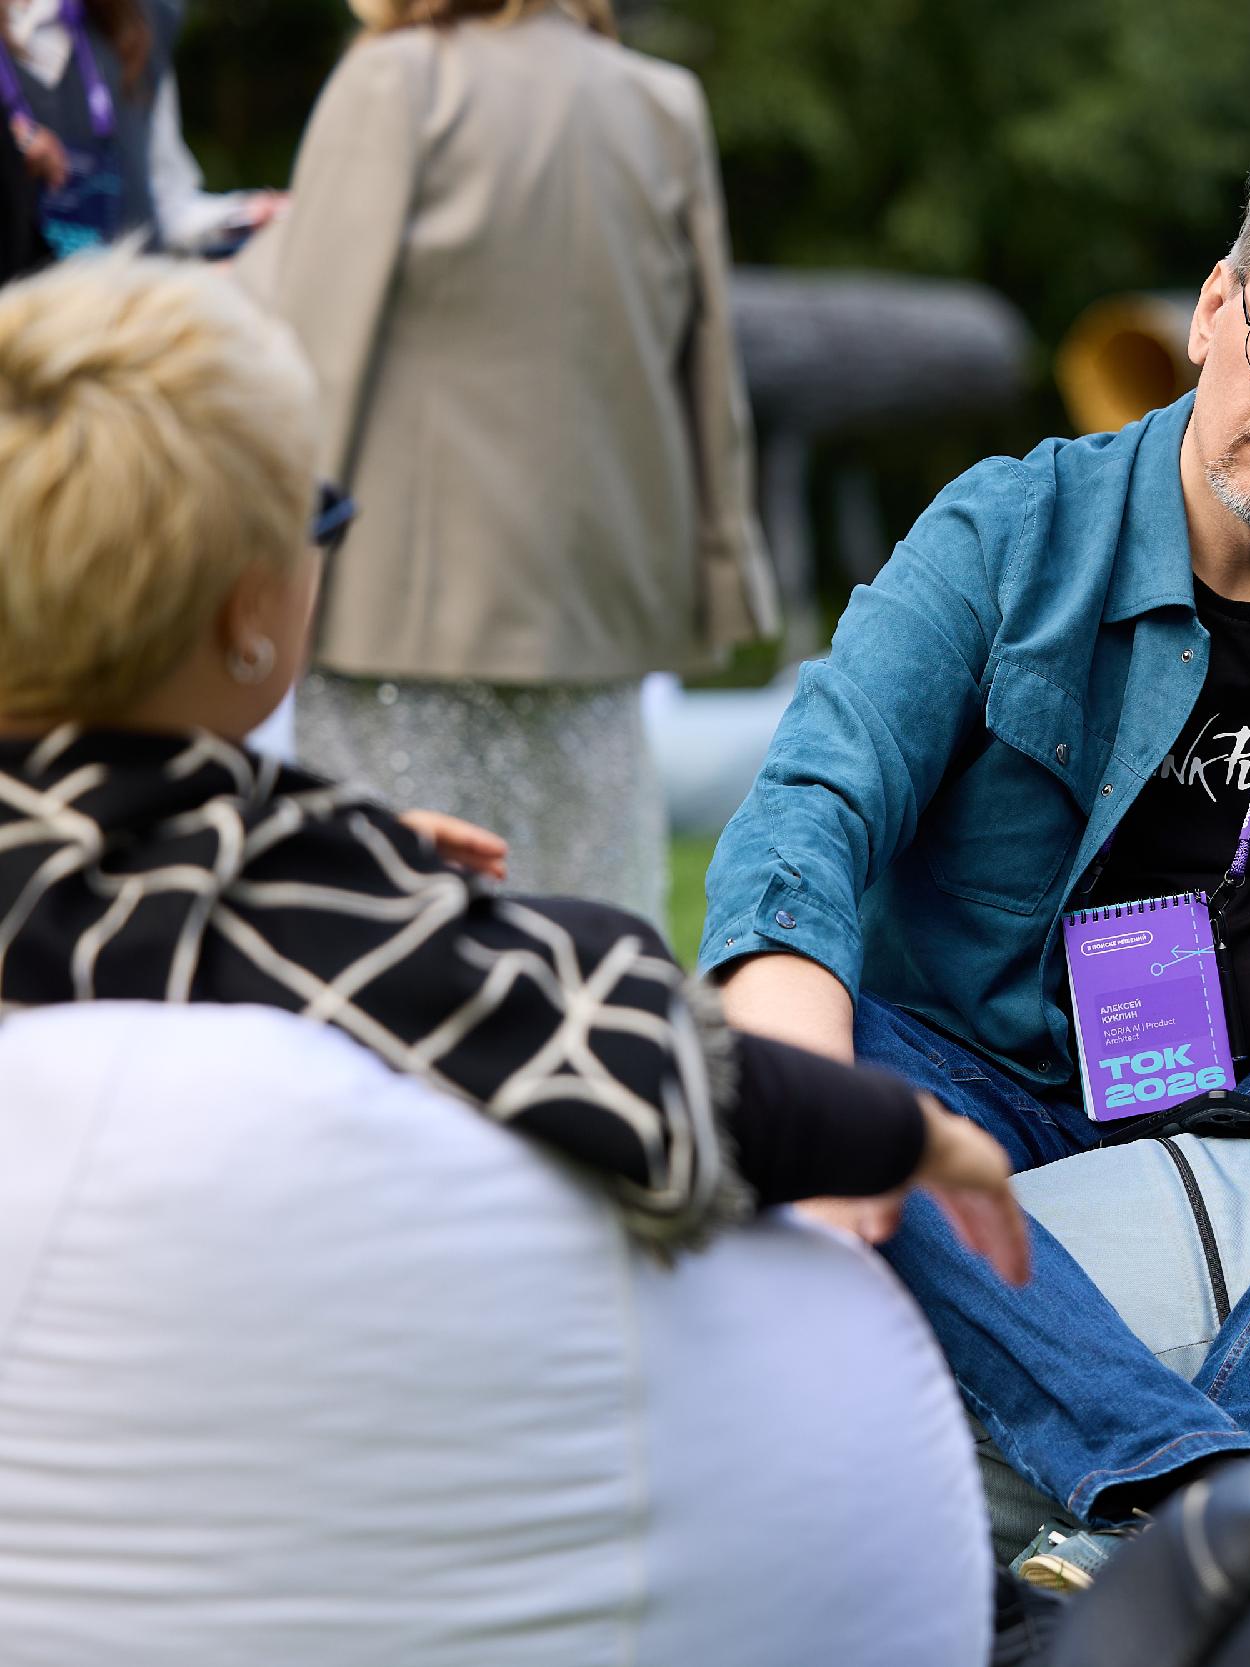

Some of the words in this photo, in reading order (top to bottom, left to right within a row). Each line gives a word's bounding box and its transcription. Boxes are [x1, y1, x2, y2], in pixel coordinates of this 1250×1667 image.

[1100, 998, 1142, 1015] АЛЕКСЕЙ
[1101, 1010, 1138, 1024] КУКЛИН
[1103, 1025, 1132, 1038] NORIA
[1145, 1018, 1176, 1029] Product
[1105, 1033, 1140, 1046] Architect
[1099, 1043, 1195, 1080] ТОК
[1105, 1066, 1227, 1109] 2026
